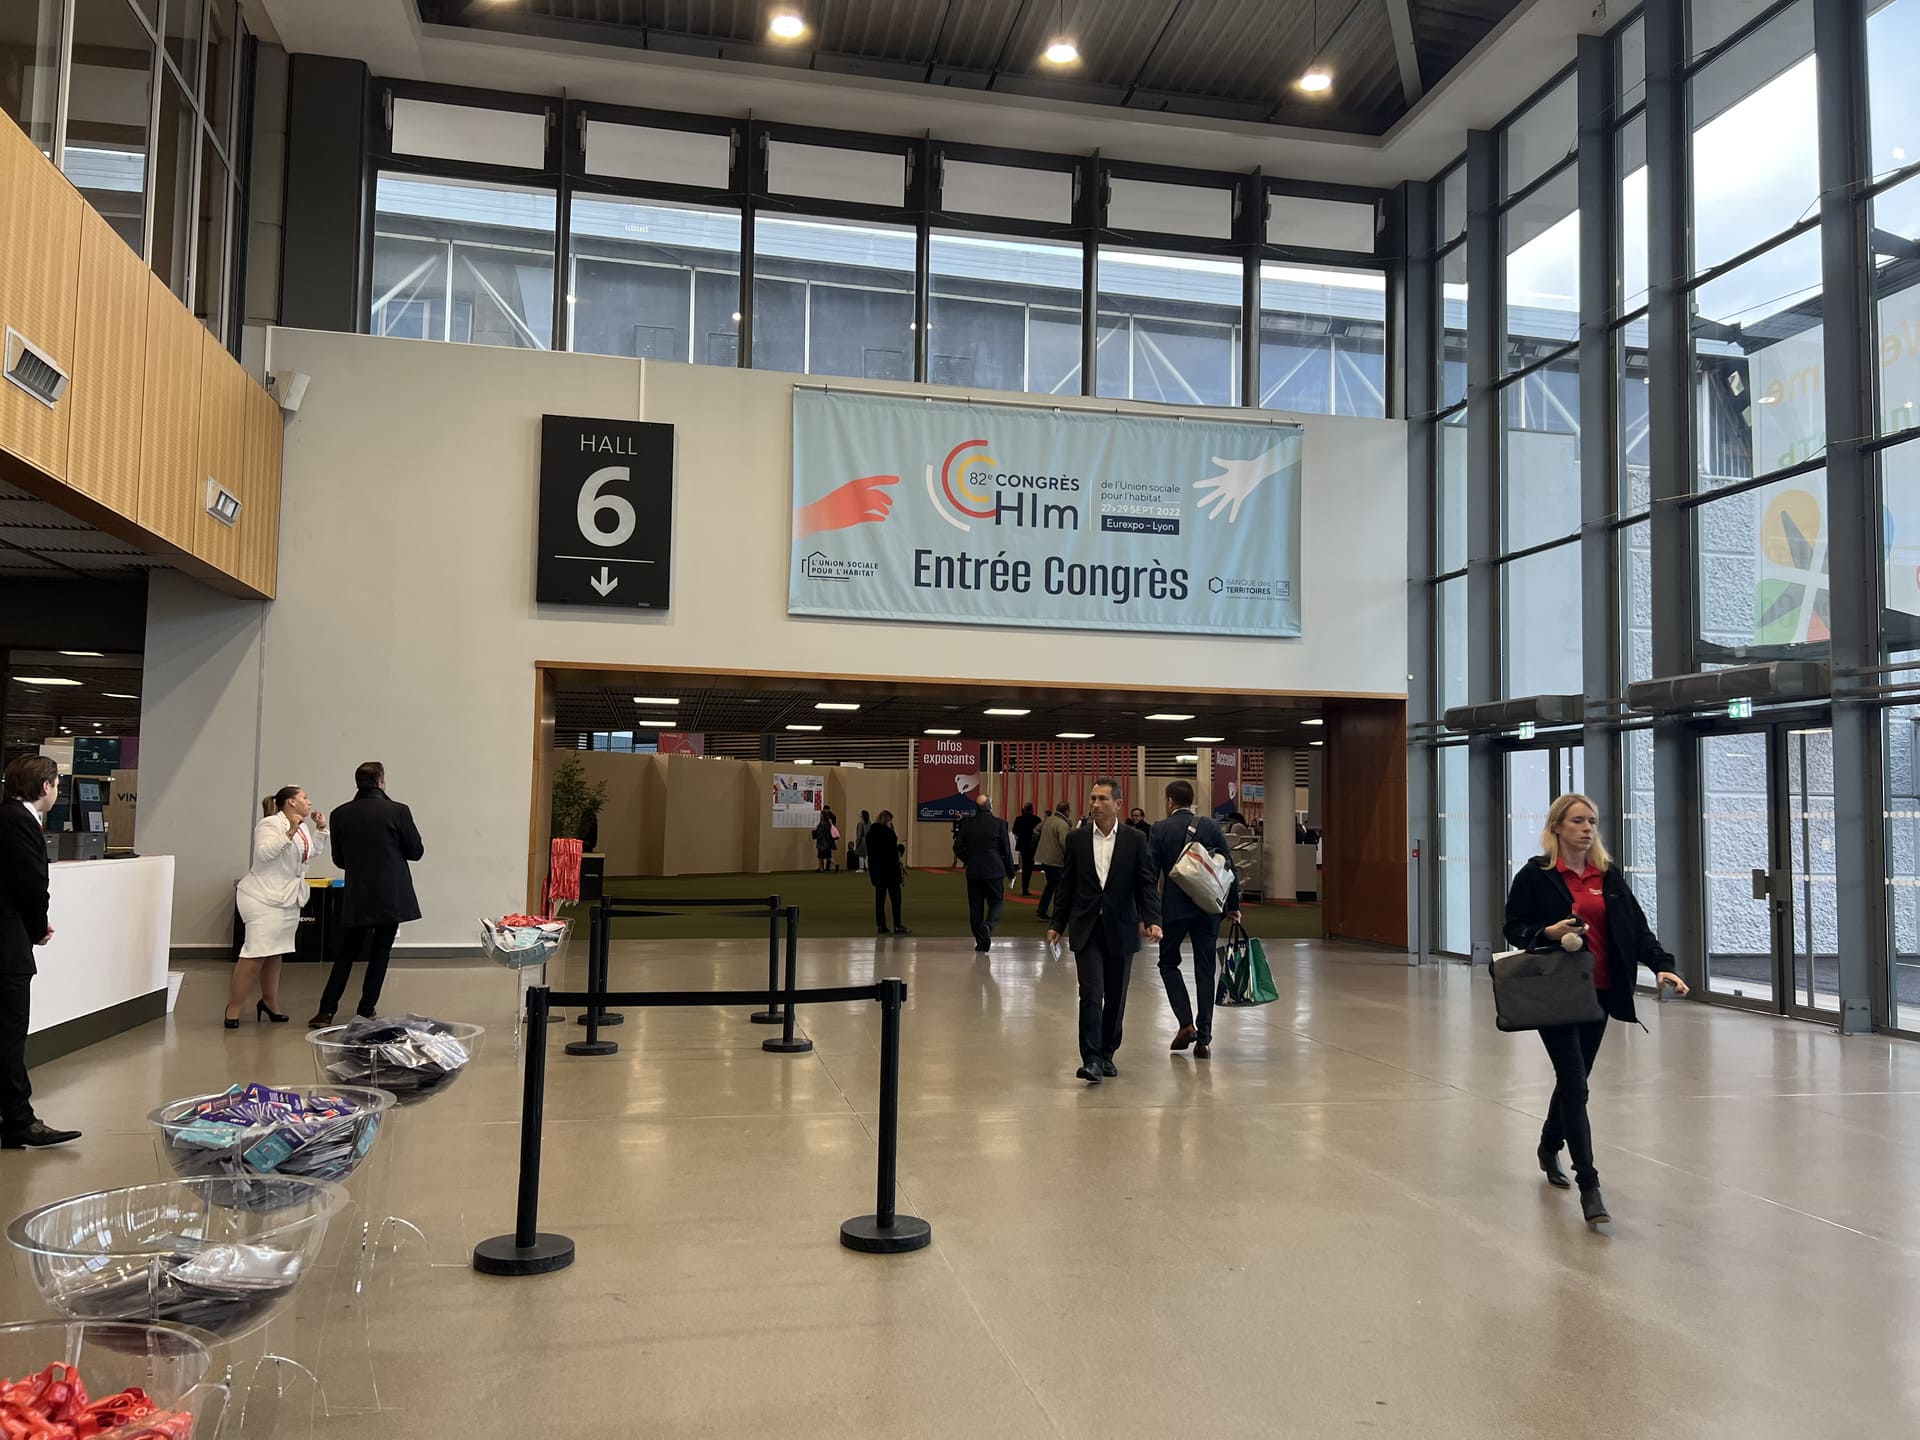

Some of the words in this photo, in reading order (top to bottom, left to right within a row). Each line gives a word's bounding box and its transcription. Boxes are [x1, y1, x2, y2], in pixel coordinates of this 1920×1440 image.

[580, 434, 638, 455] HALL
[996, 474, 1080, 491] CONGRÈS
[1101, 480, 1113, 489] de
[1115, 481, 1147, 491] l'Union
[1149, 484, 1180, 493] sociale
[1101, 492, 1122, 500] pour
[1125, 492, 1161, 502] l'habitat
[577, 466, 636, 547] 6
[995, 490, 1079, 530] Hlm
[1130, 505, 1154, 515] SEPT
[1157, 506, 1180, 516] 2022
[1106, 518, 1144, 530] Eurexpo
[1152, 521, 1174, 532] Lyon
[812, 559, 844, 567] L'UNION
[847, 561, 879, 570] SOCIALE
[812, 567, 833, 575] POUR
[836, 568, 874, 577] L'HABITAT
[914, 549, 1031, 593] Entrée
[1044, 556, 1189, 604] Congrès
[1226, 586, 1271, 595] TERRITOIRES
[937, 740, 962, 752] Infos
[923, 753, 975, 766] exposants
